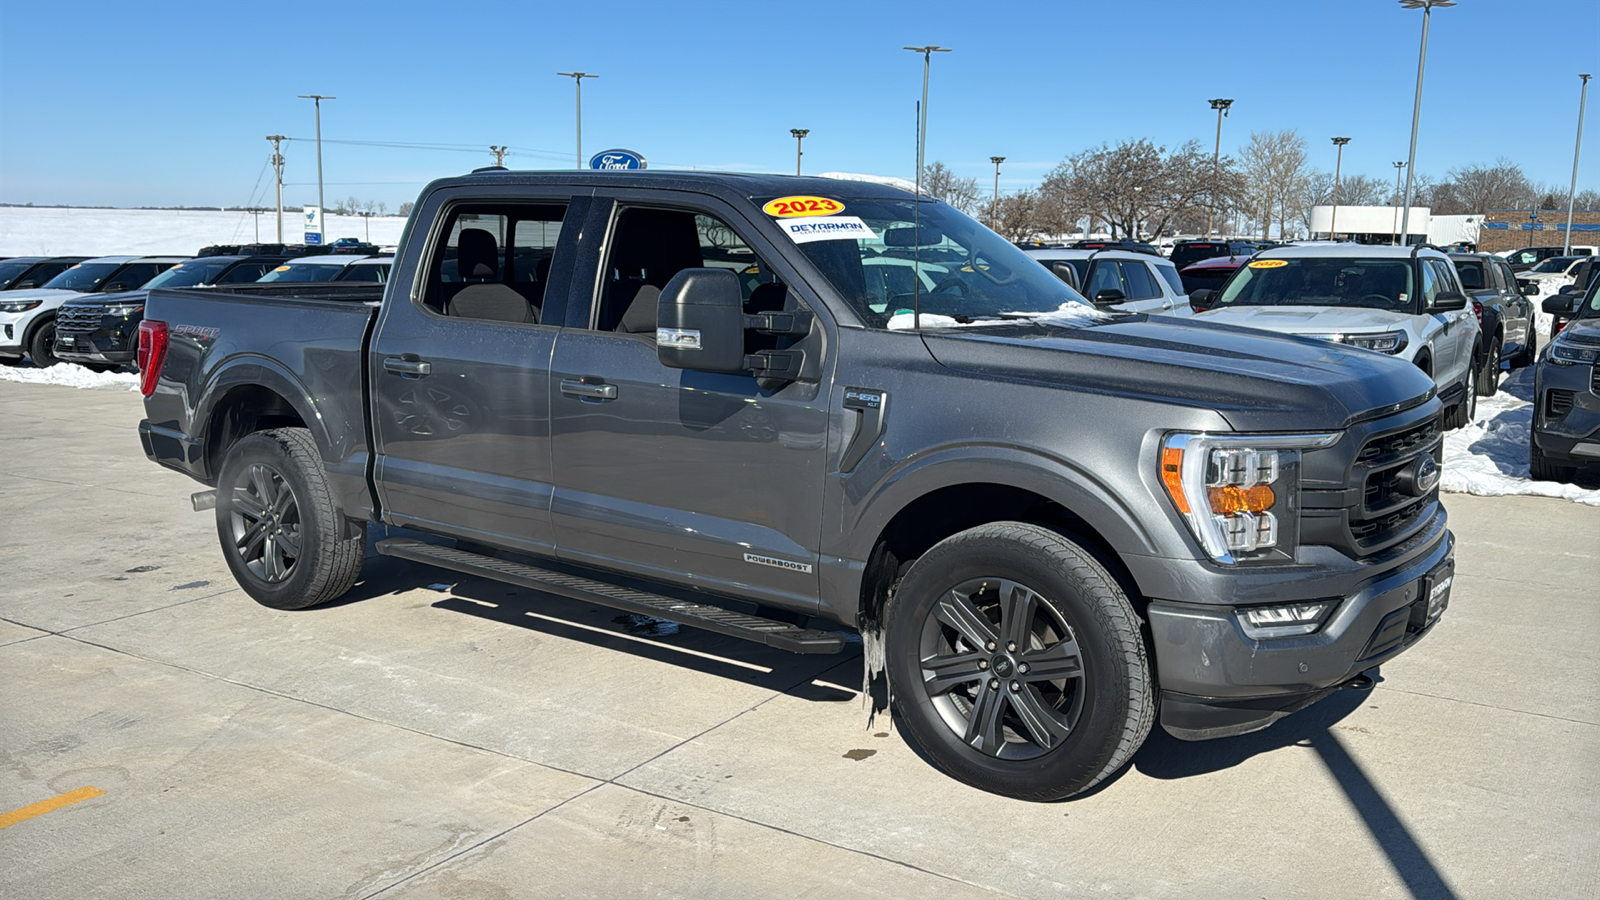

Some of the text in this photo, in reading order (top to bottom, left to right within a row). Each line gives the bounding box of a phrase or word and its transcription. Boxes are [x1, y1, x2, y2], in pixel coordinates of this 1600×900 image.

[599, 155, 630, 170] Ford
[773, 199, 838, 215] 2023
[790, 222, 863, 233] DEYARMAN
[172, 323, 220, 336] SPORT
[846, 391, 880, 402] F-150
[746, 554, 808, 571] POWERBOOST
